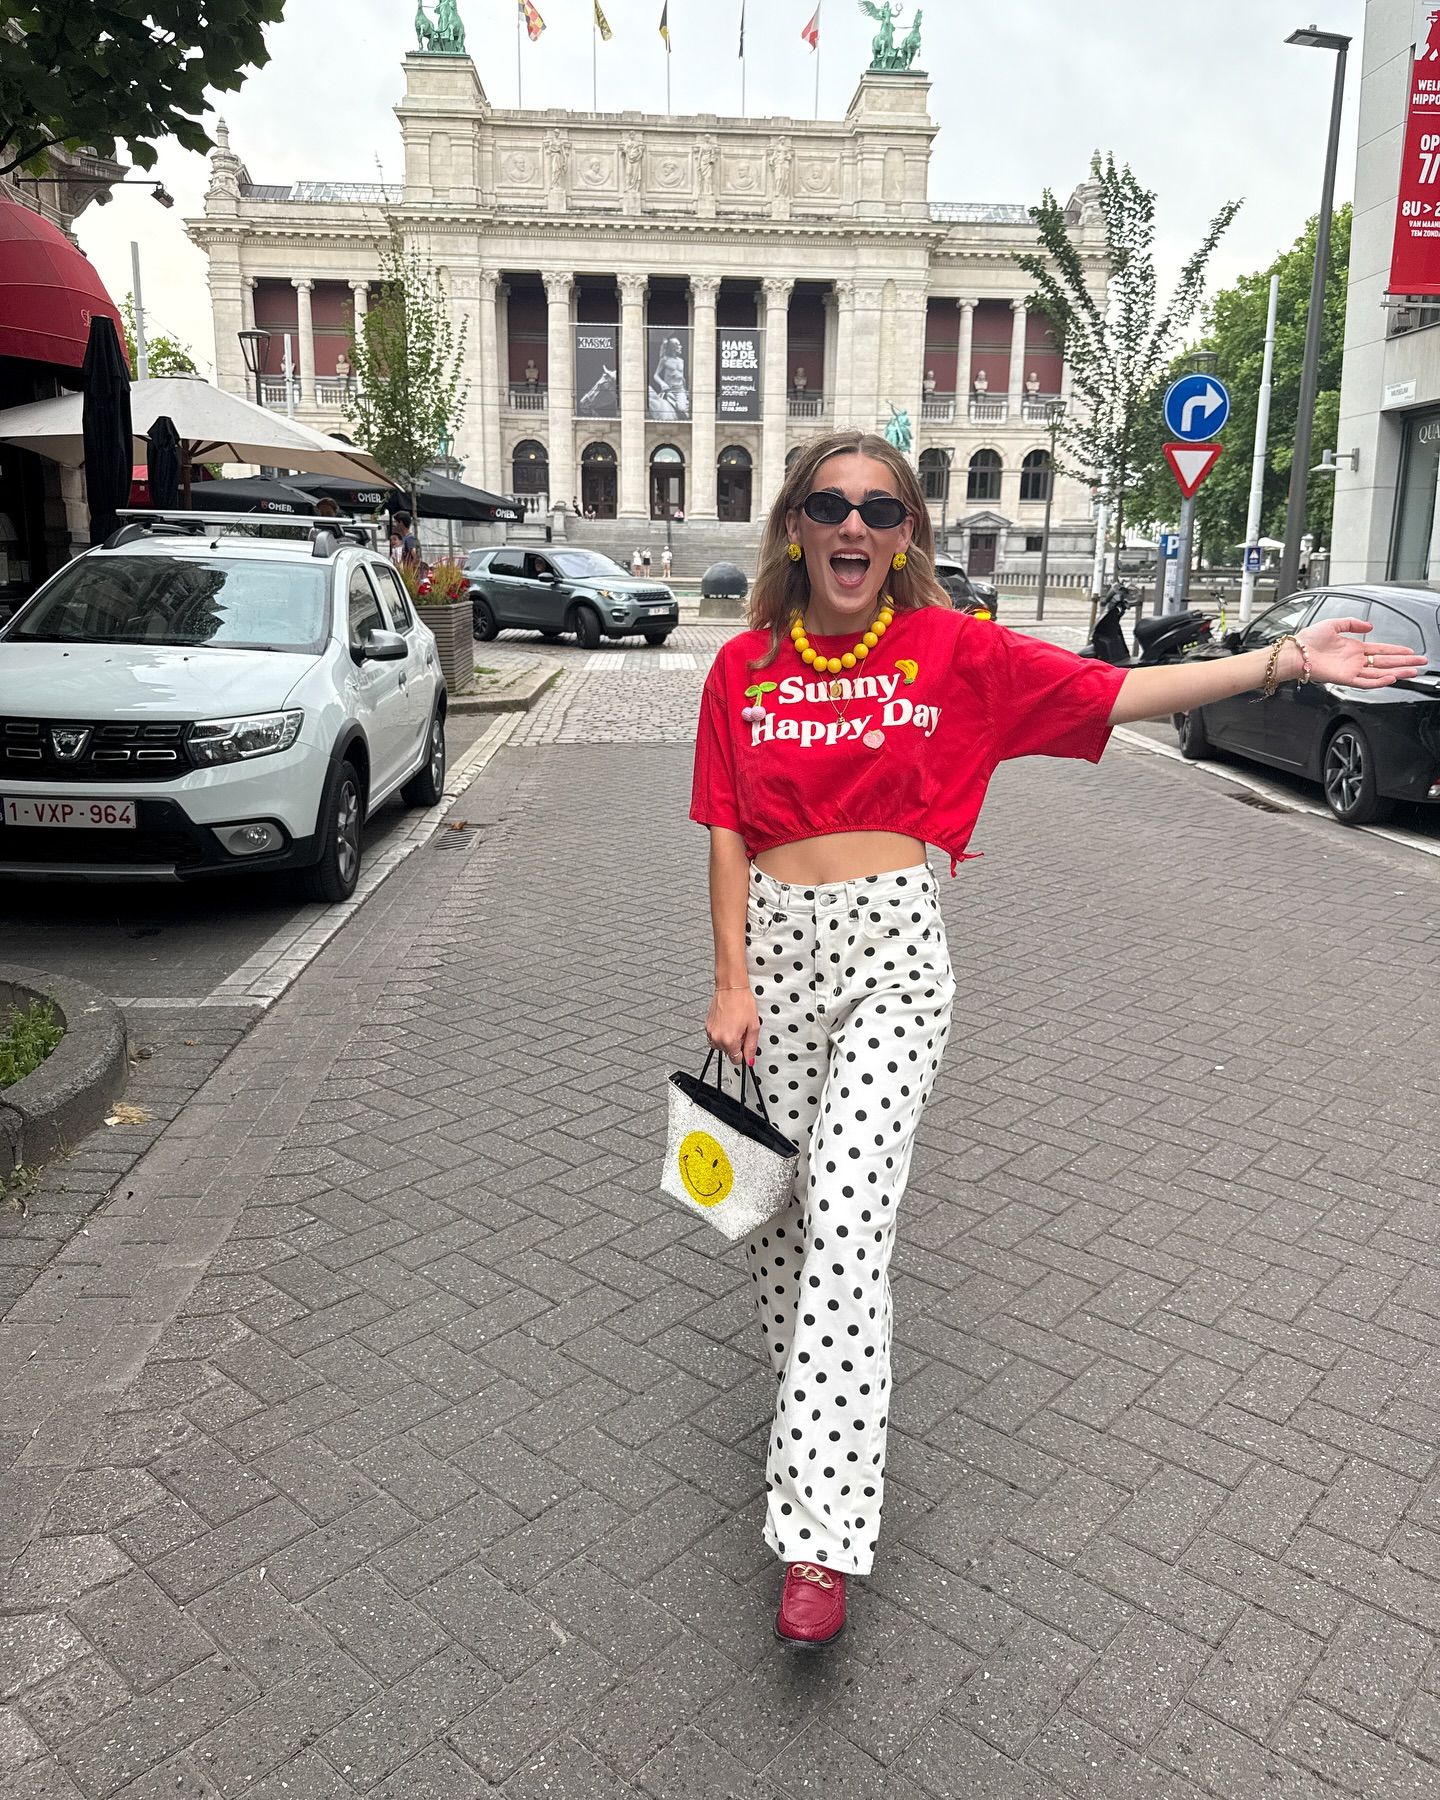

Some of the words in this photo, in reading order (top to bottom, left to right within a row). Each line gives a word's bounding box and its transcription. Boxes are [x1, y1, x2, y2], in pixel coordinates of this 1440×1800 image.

[1420, 134, 1440, 151] OP
[1402, 200, 1421, 217] 8U
[721, 340, 753, 351] HANS
[721, 350, 739, 360] OP
[740, 350, 755, 360] DE
[721, 359, 758, 369] BEECK
[778, 673, 900, 704] Sunny
[751, 712, 873, 748] Happy
[882, 698, 942, 738] Day
[9, 802, 132, 824] 1-VXP-964
